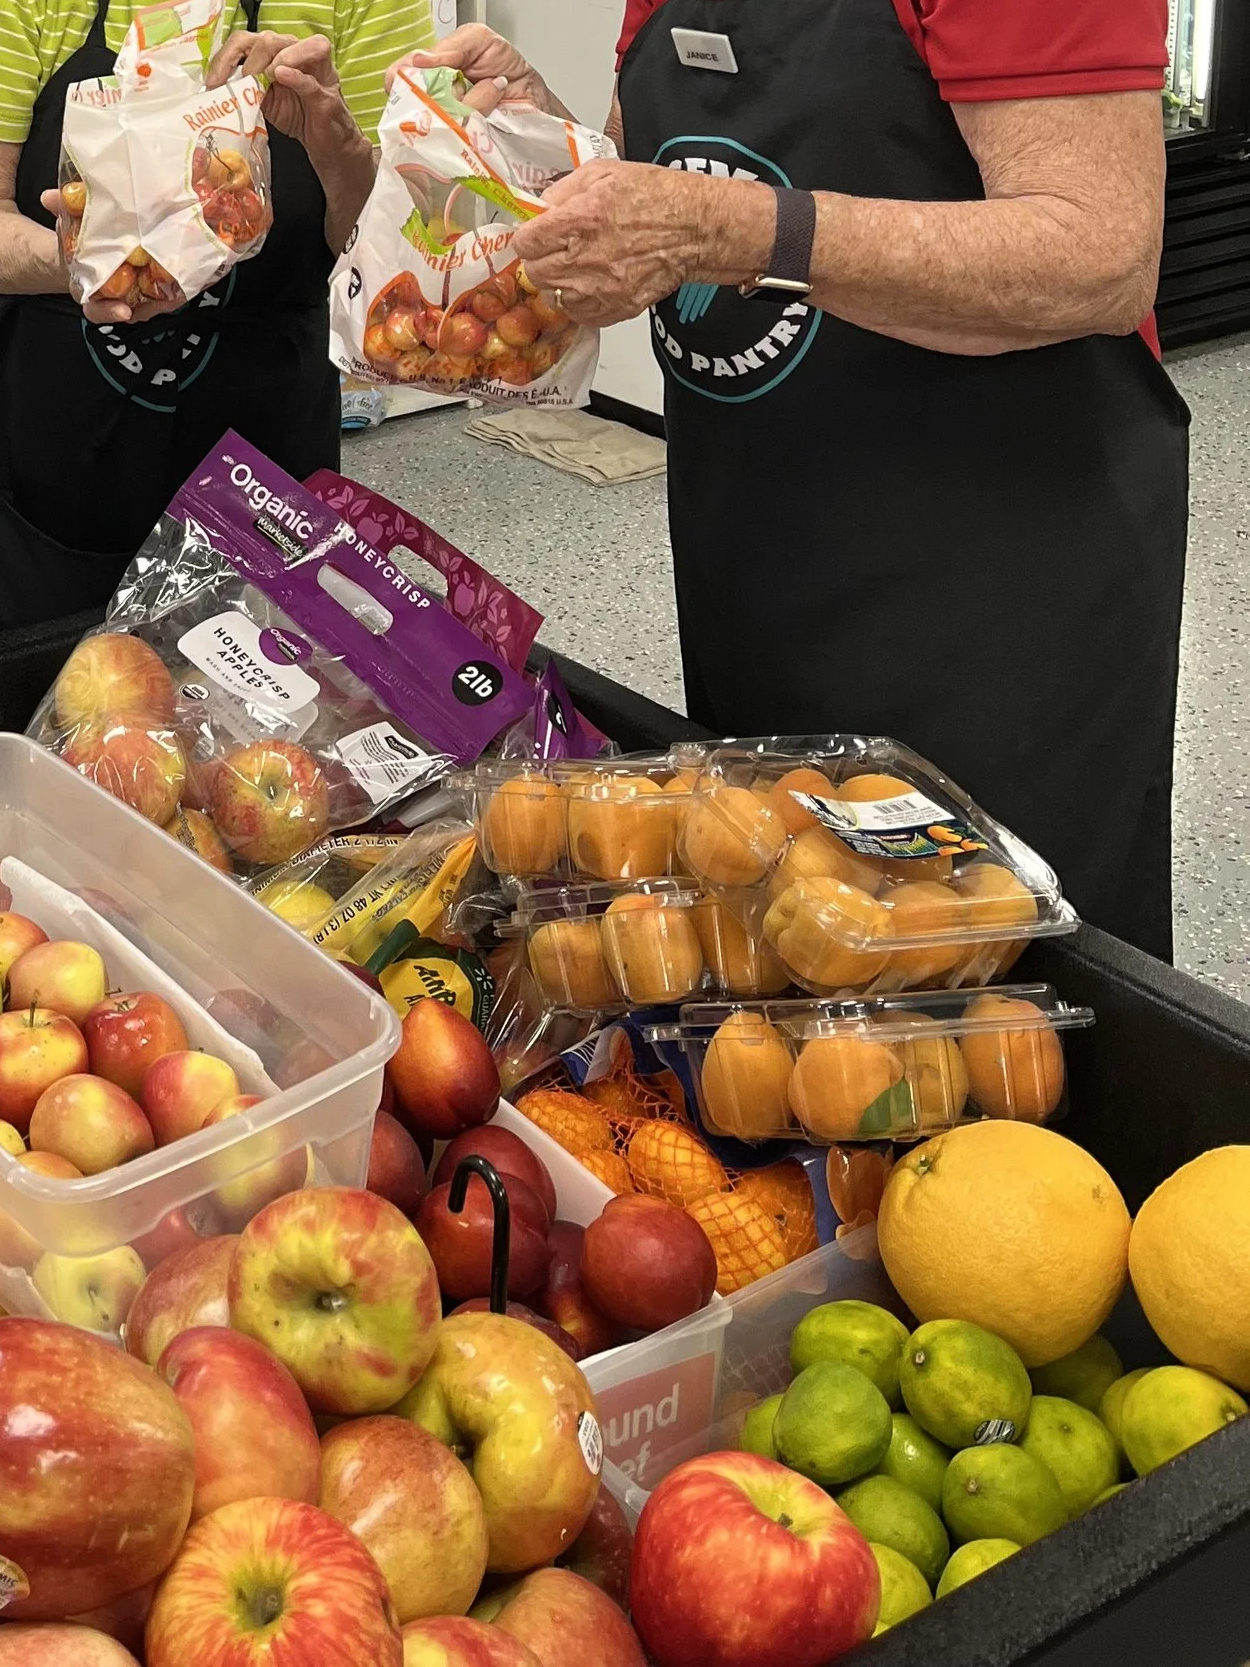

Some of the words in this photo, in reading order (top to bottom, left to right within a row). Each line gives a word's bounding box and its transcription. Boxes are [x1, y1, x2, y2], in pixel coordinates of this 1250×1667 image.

[183, 97, 239, 132] Rainier
[690, 302, 808, 377] PANTRY
[230, 463, 313, 540] Organic
[333, 521, 431, 609] HONEYCRISP
[213, 627, 291, 700] HONEYCRISP
[216, 650, 264, 688] APPLES
[457, 665, 493, 698] 2lb
[353, 897, 368, 912] 48
